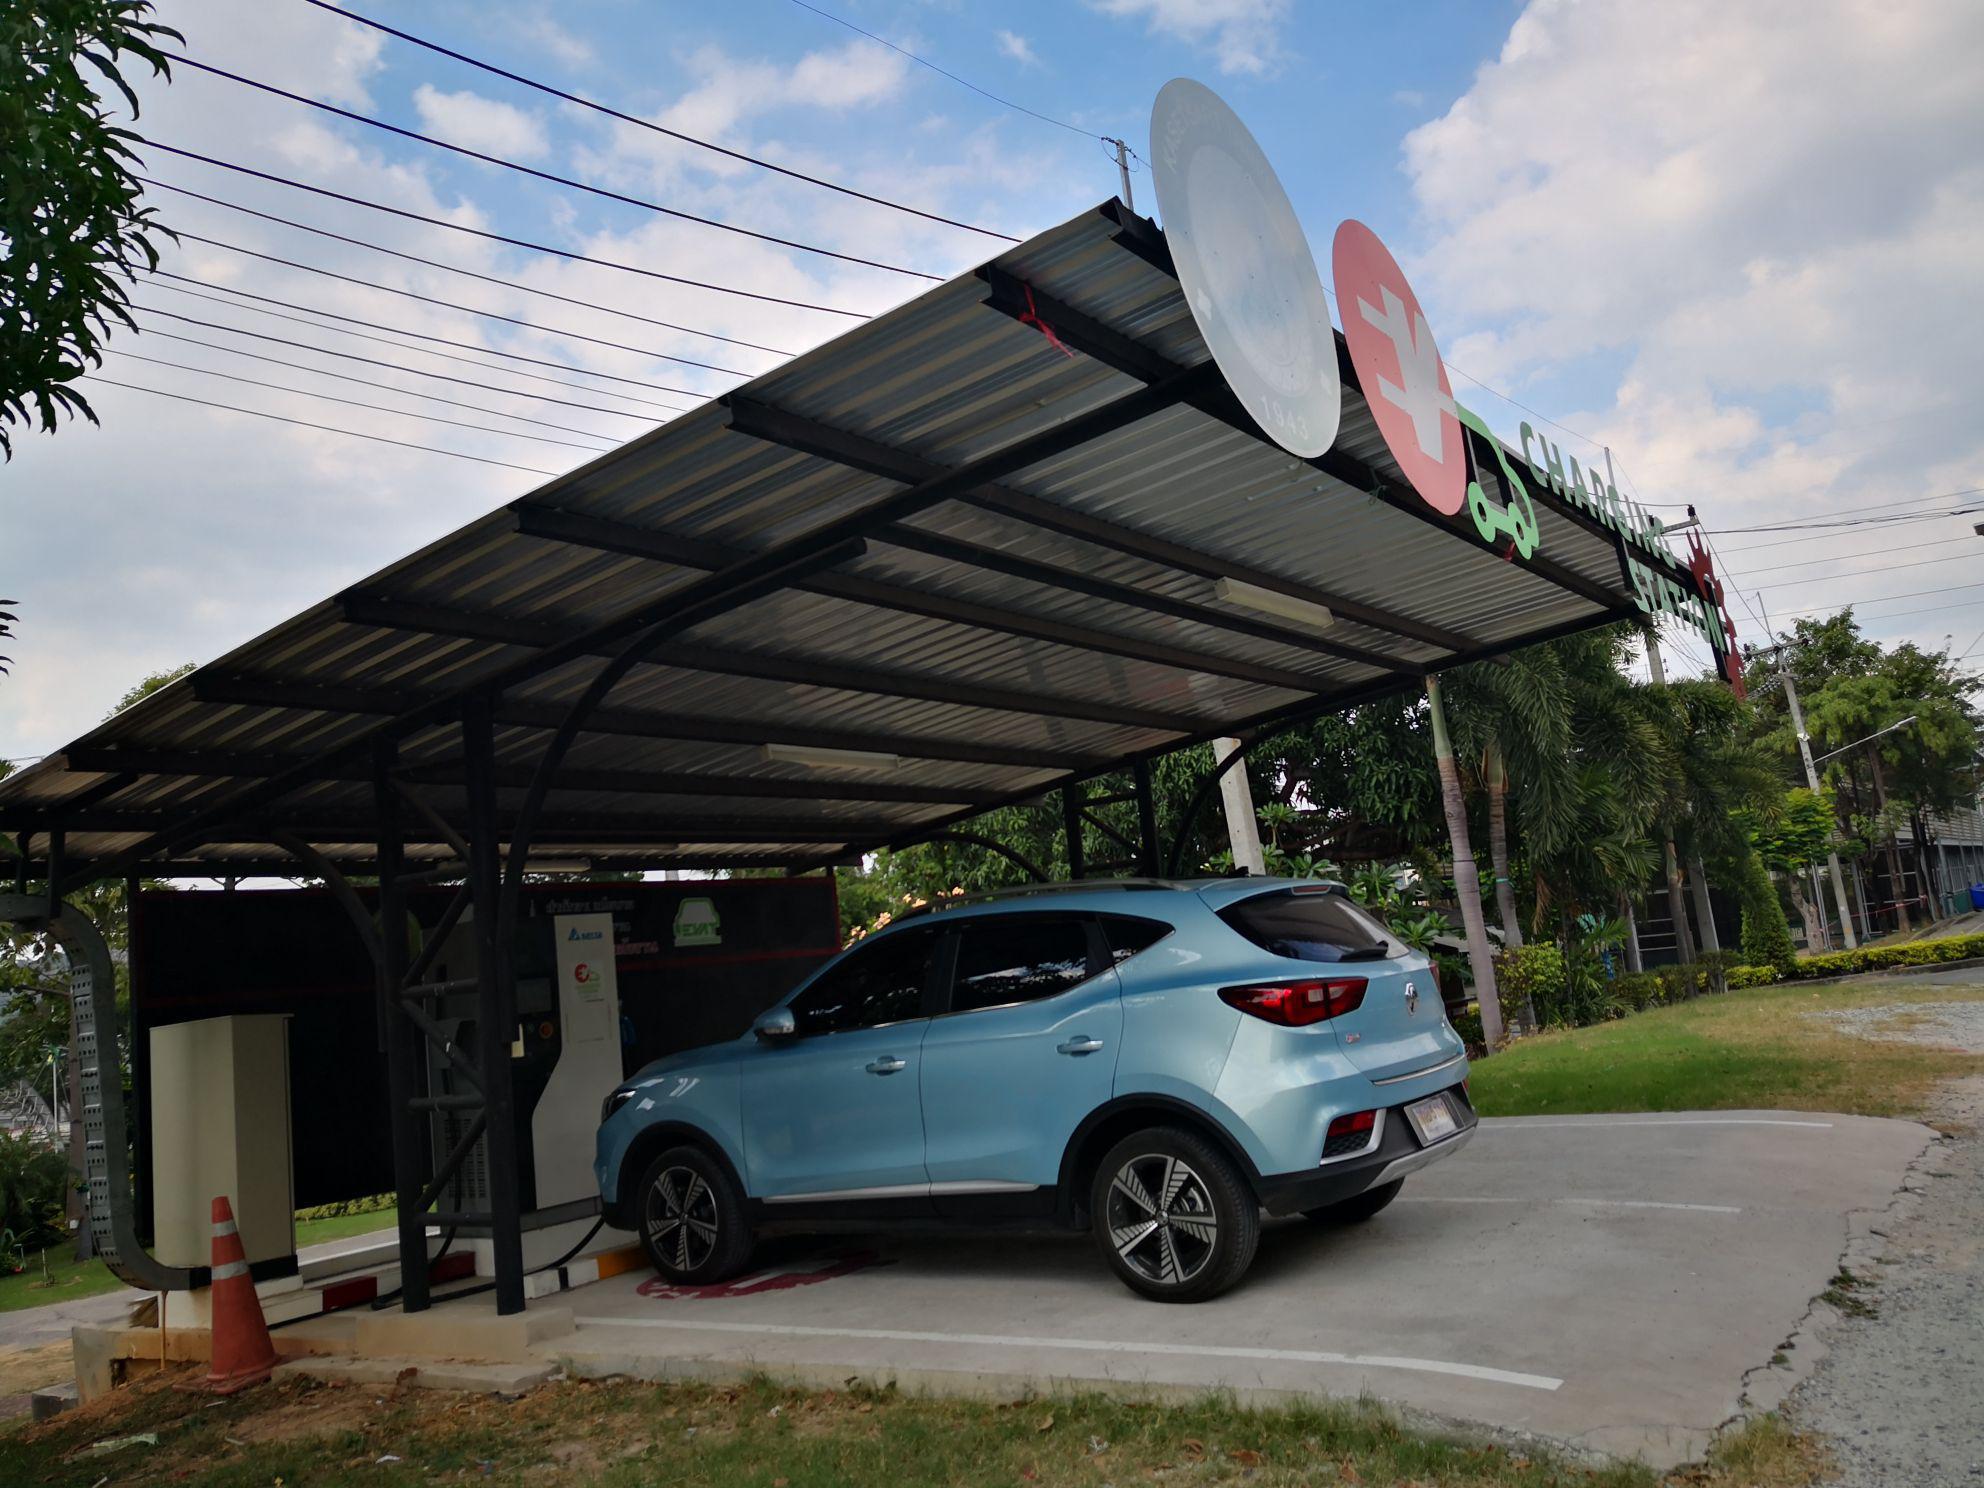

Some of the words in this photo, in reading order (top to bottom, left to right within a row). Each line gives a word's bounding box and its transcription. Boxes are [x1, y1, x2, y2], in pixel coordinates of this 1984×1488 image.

[1260, 395, 1308, 440] 1943
[1520, 421, 1677, 569] CHARGING
[1628, 557, 1732, 655] STATION
